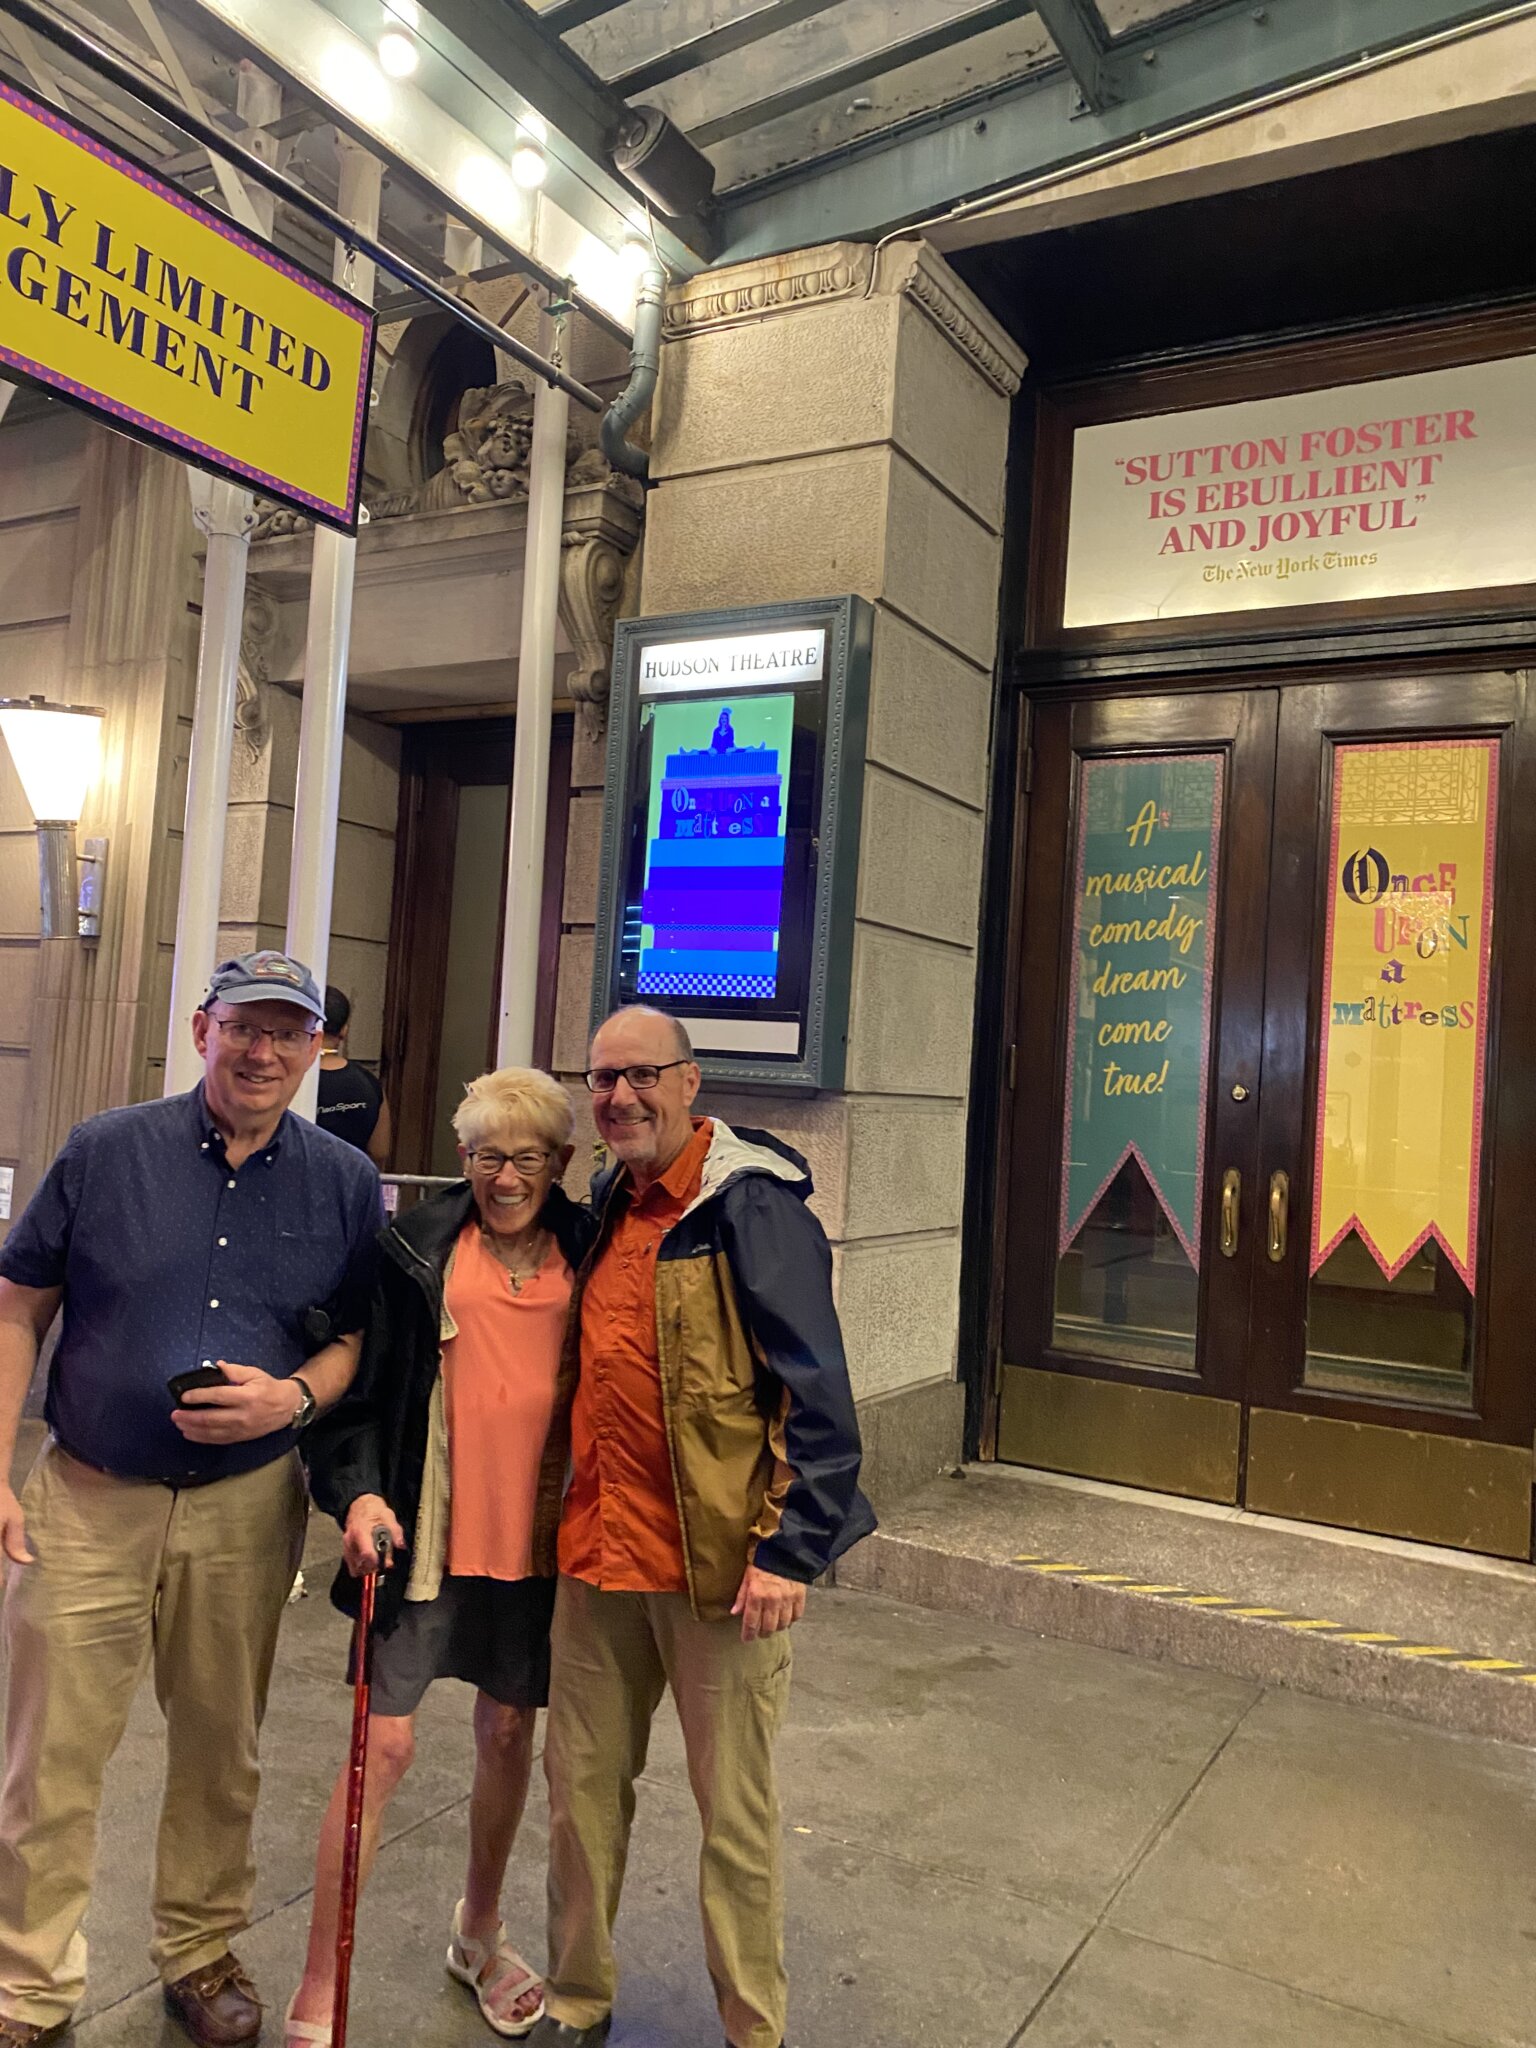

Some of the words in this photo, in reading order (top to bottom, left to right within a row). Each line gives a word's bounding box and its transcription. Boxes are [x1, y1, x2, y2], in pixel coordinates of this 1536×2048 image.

[0, 164, 77, 248] LY
[90, 220, 332, 393] LIMITED
[0, 246, 265, 414] GEMENT
[1299, 409, 1479, 462] FOSTER
[1147, 488, 1186, 520] IS
[1194, 453, 1443, 514] EBULLIENT
[1157, 518, 1247, 555] AND
[1202, 564, 1233, 583] The
[1236, 561, 1272, 581] New
[1276, 554, 1320, 579] York
[1322, 551, 1378, 570] Times
[645, 656, 719, 679] HUDSON
[728, 647, 818, 672] THEATRE
[760, 795, 770, 808] a
[1126, 800, 1159, 847] A
[1085, 850, 1206, 897] musical
[1088, 903, 1203, 954] comedy
[1092, 960, 1187, 997] dream
[1380, 958, 1407, 984] a
[1097, 1018, 1173, 1046] come
[1103, 1060, 1170, 1096] true!
